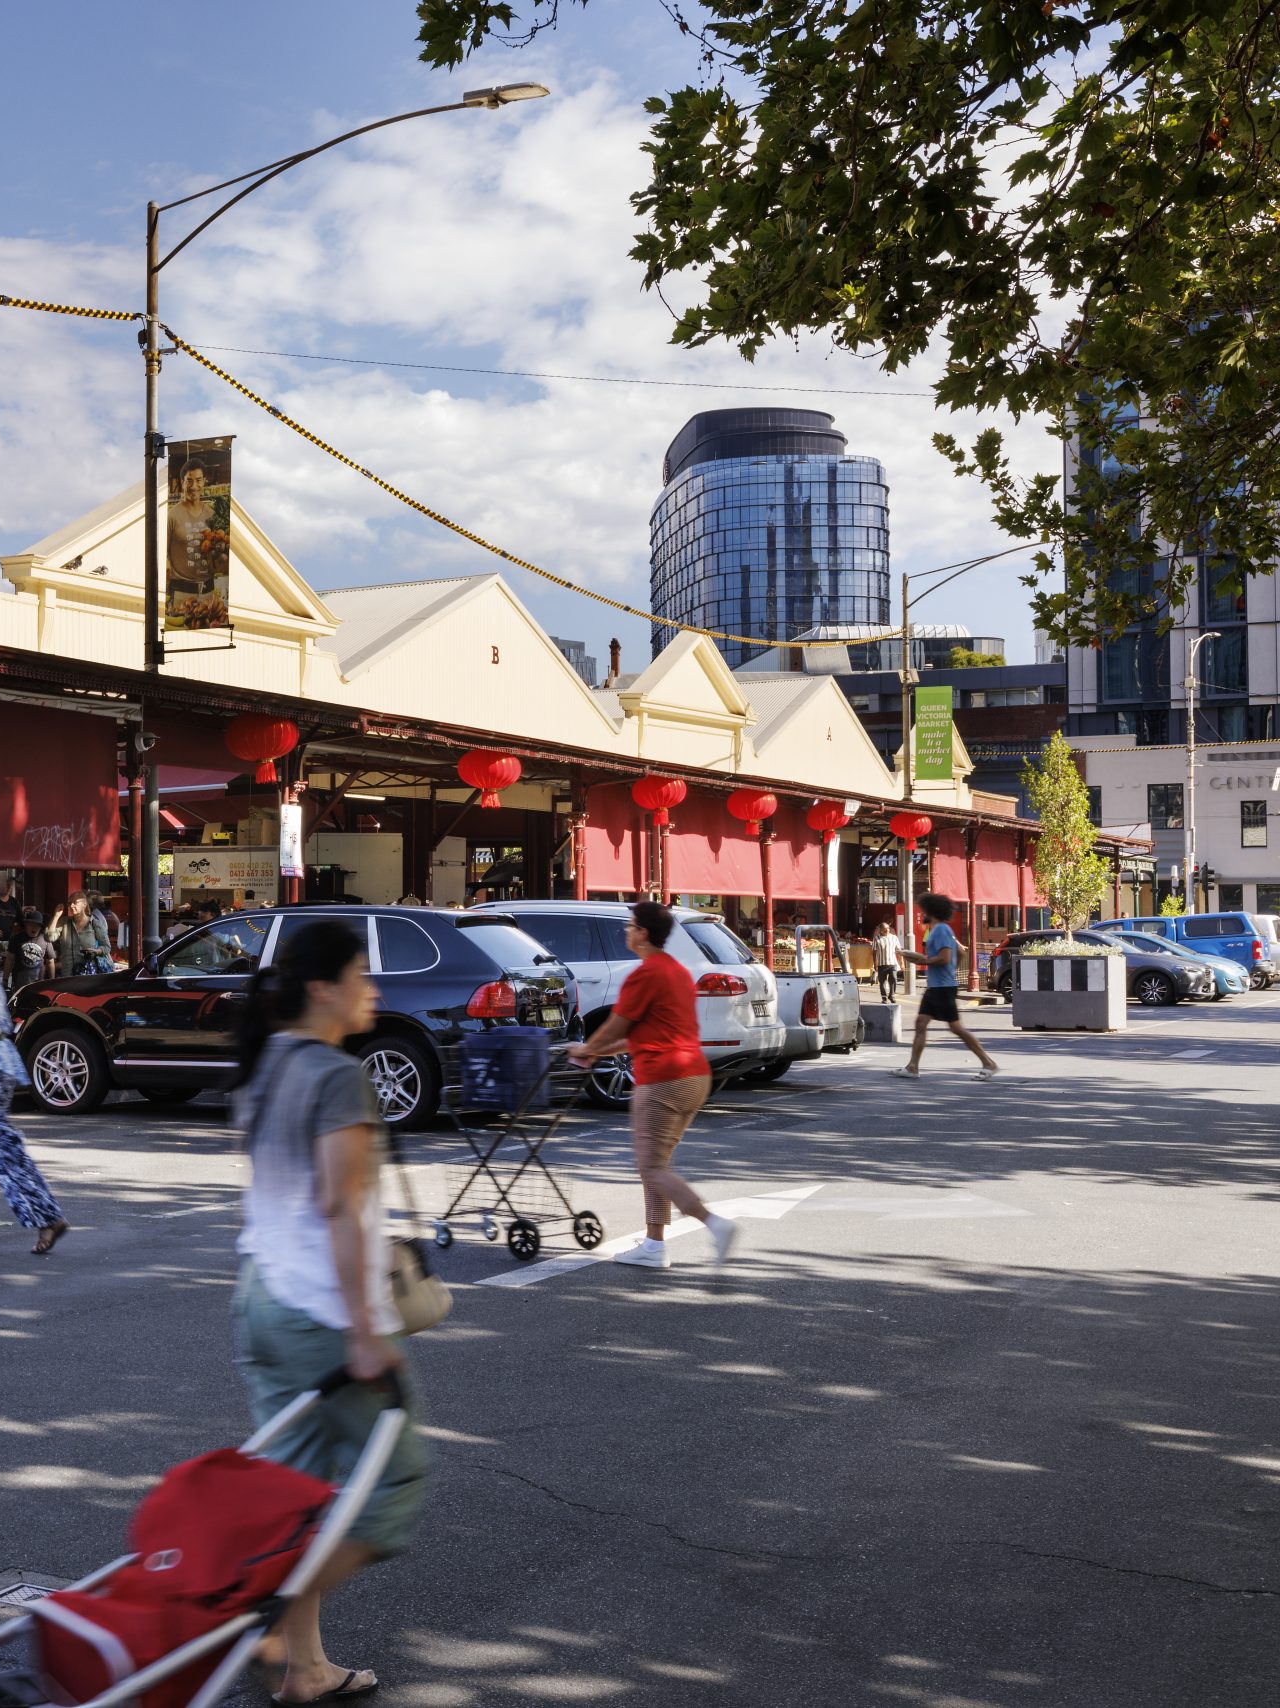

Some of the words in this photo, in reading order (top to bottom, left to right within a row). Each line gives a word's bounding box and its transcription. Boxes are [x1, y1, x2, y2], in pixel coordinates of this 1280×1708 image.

[491, 645, 499, 664] B
[920, 704, 947, 712] QUEEN
[916, 712, 952, 720] VICTORIA
[918, 720, 950, 728] MARKET
[826, 725, 833, 742] A
[922, 730, 947, 739] make
[918, 746, 951, 755] market
[925, 755, 943, 765] day
[229, 869, 245, 877] 0413
[247, 869, 259, 877] 667
[261, 869, 274, 877] 353
[203, 874, 222, 885] Boys
